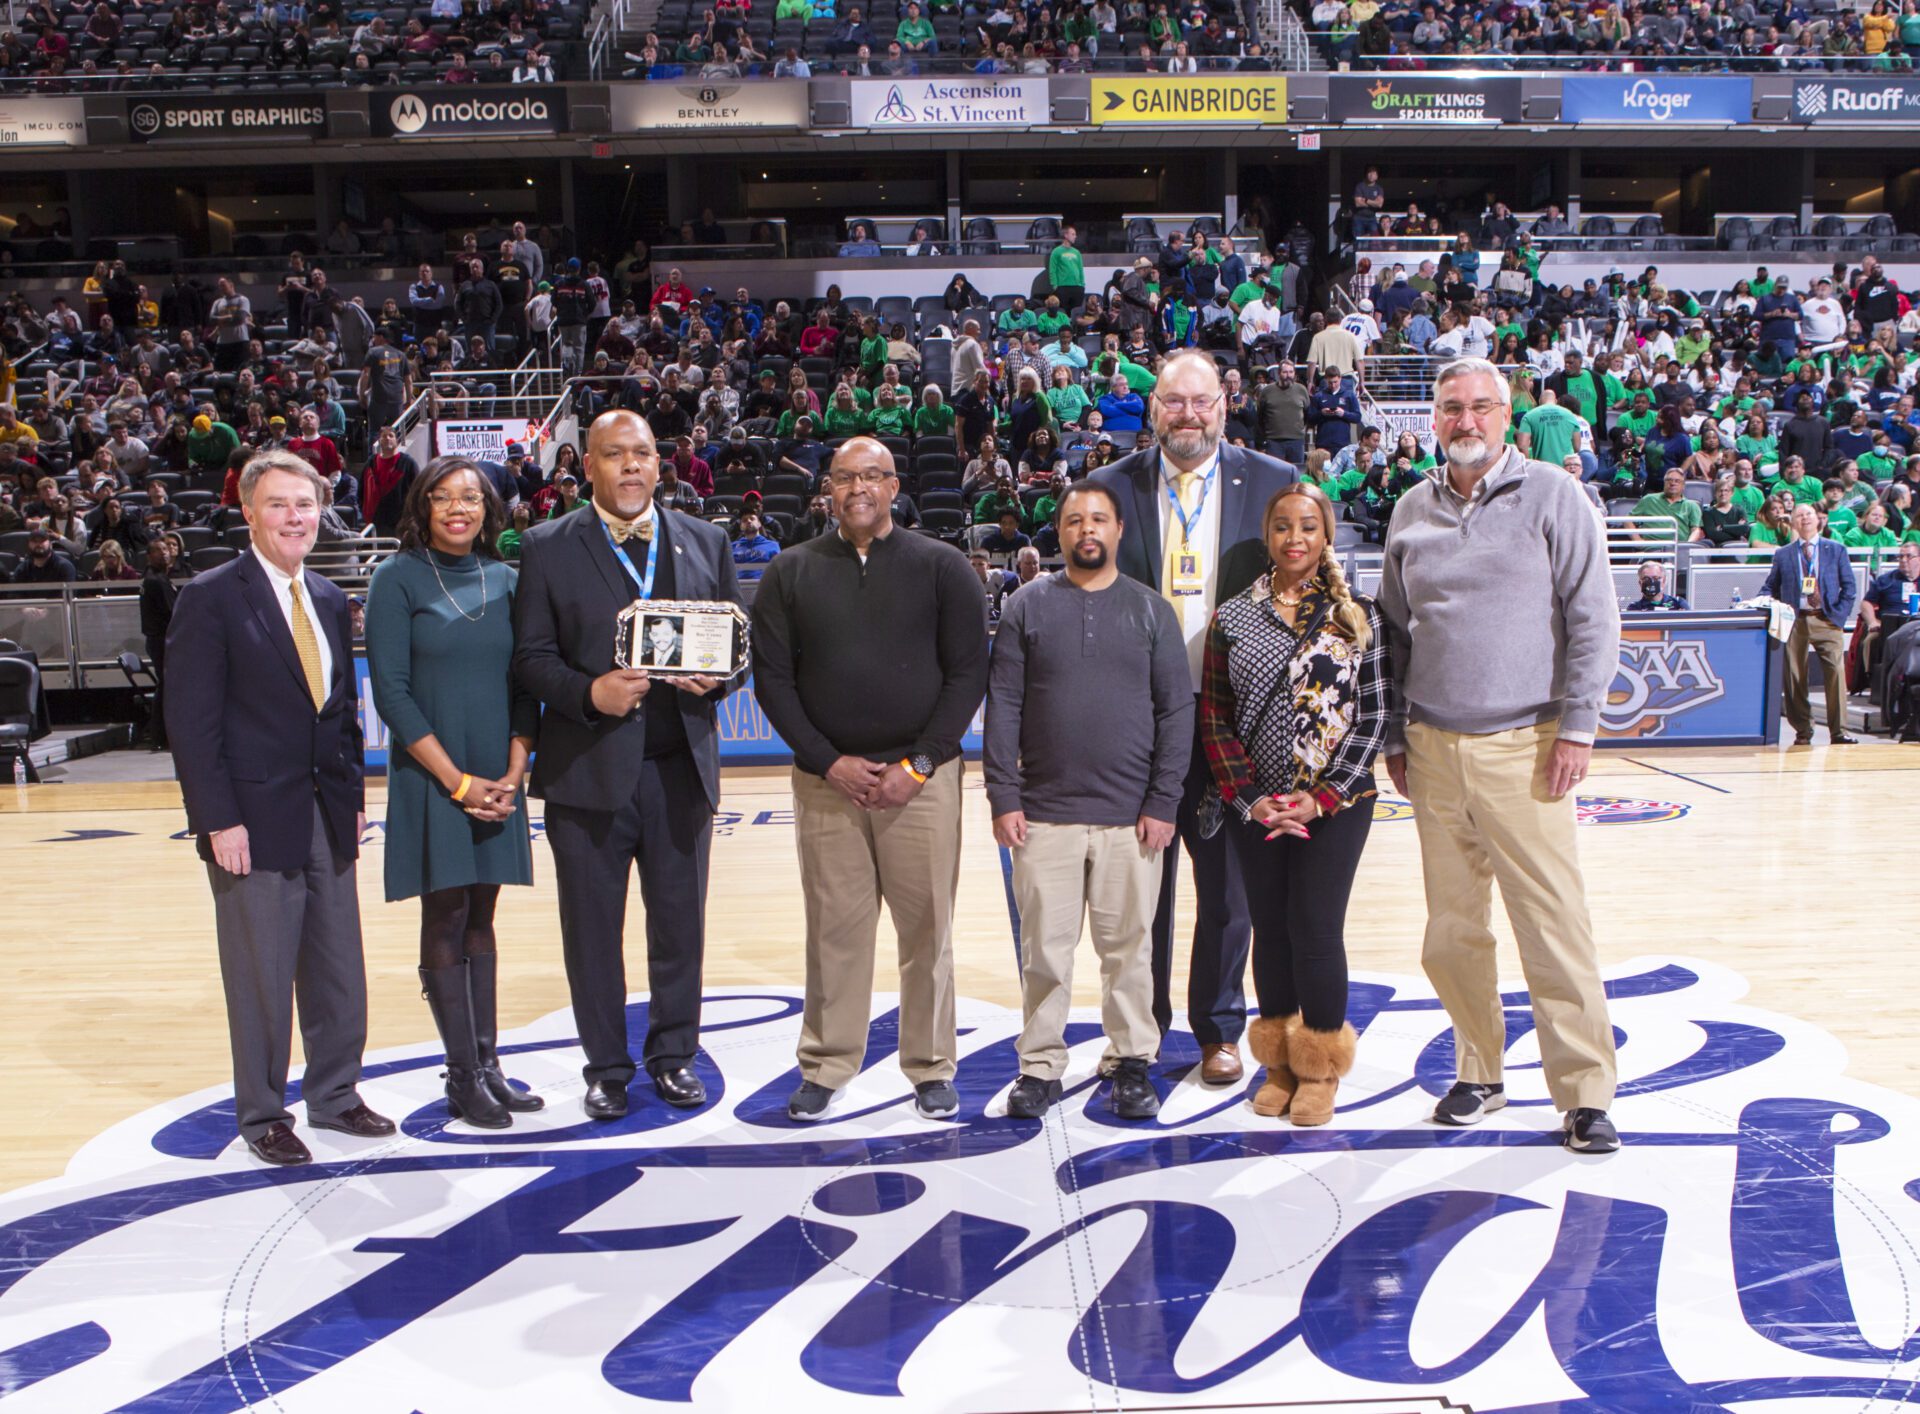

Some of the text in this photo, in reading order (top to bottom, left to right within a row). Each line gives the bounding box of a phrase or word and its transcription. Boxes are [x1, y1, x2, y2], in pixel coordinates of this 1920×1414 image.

[923, 82, 1022, 99] Ascension
[1832, 88, 1904, 110] Ruoff
[1132, 88, 1276, 112] GAINBRIDGE
[1371, 93, 1485, 110] DRAFTKINGS
[165, 107, 324, 128] SPORT GRAPHICS
[432, 98, 548, 122] motorola
[678, 108, 739, 119] BENTLEY
[923, 105, 1026, 122] St. Vincent
[1399, 109, 1484, 119] SPORTSBOOK
[24, 121, 84, 132] IMCU.COM
[1302, 134, 1317, 147] EXIT
[1385, 416, 1432, 432] ASKETBALL
[456, 432, 504, 449] BASKETBALL
[1600, 645, 1717, 716] SAA
[0, 1096, 1920, 1414] Final
